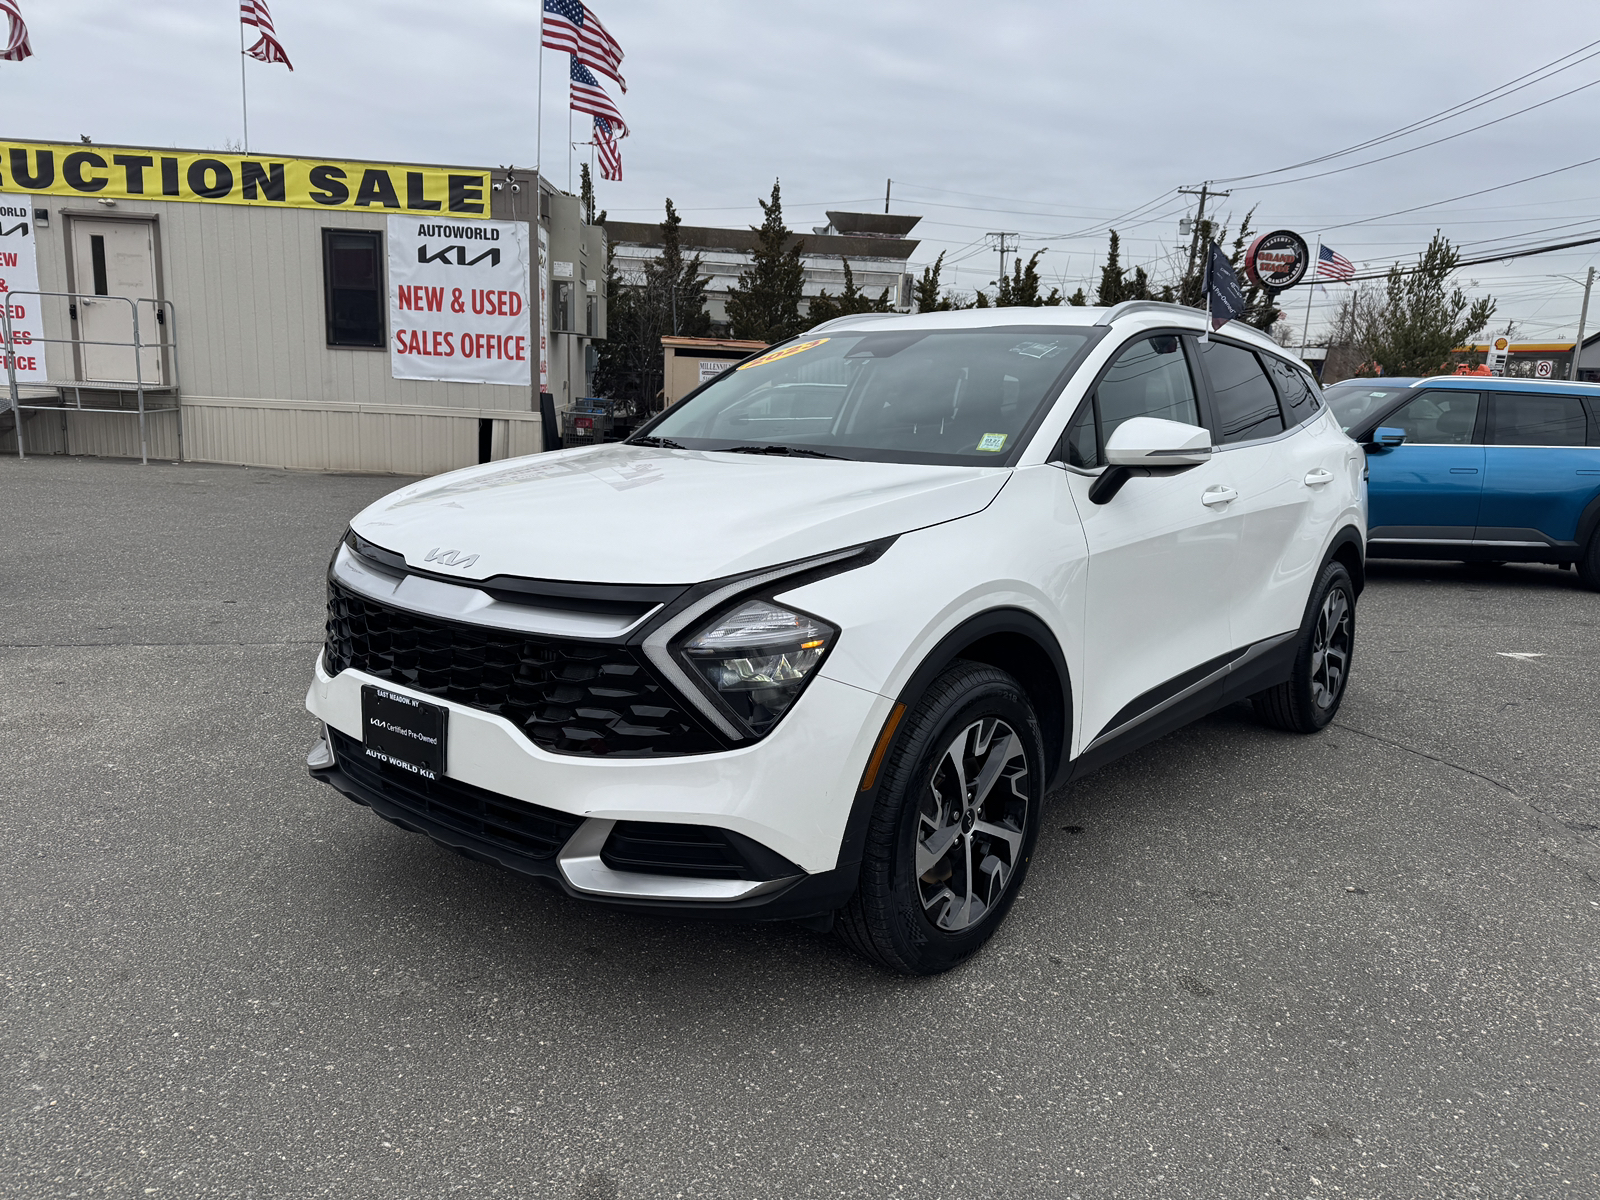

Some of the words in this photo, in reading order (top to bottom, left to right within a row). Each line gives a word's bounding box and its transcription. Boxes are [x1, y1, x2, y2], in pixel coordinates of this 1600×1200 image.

[0, 148, 286, 202] UCTION
[309, 165, 484, 213] SALE
[417, 224, 500, 241] AUTOWORLD
[417, 244, 500, 267] KIA
[1257, 251, 1296, 263] GRAND
[1259, 262, 1291, 273] STAGE
[398, 284, 445, 313] NEW
[450, 287, 466, 314] &
[471, 289, 522, 317] USED
[0, 330, 33, 346] ES
[396, 329, 454, 358] SALES
[460, 332, 526, 361] OFFICE
[424, 547, 480, 569] KIA
[377, 689, 389, 699] EAST
[411, 700, 420, 708] NY
[370, 717, 386, 728] KIA
[386, 723, 408, 736] Certified
[408, 729, 437, 745] Pre-Owned
[366, 749, 387, 761] AUTO
[389, 757, 418, 773] WORLD
[420, 769, 435, 780] KIA
